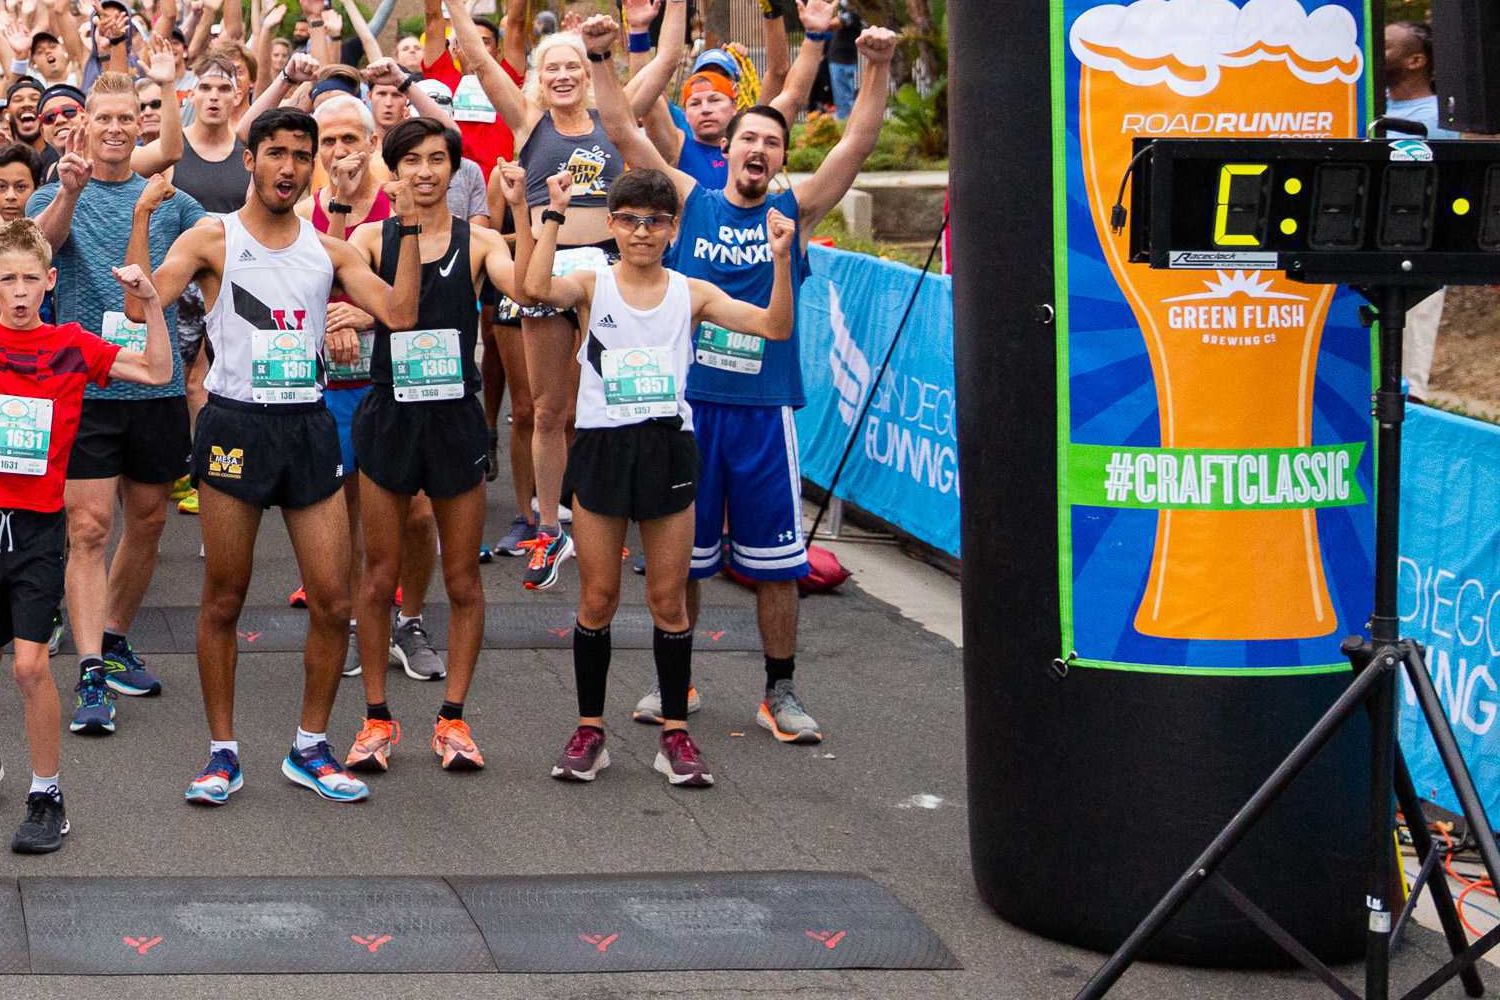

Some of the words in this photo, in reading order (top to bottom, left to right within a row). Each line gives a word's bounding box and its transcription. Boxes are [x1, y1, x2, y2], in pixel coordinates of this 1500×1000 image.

[719, 223, 765, 245] RVM
[1168, 305, 1237, 329] GREEN
[1243, 304, 1304, 329] FLASH
[1202, 334, 1260, 345] BREWING
[281, 360, 312, 379] 1361
[420, 358, 459, 377] 1360
[634, 376, 669, 394] 1357
[5, 428, 43, 450] 1631
[1, 460, 19, 470] 1631
[215, 455, 238, 465] MESA
[1104, 450, 1350, 505] #CRAFTCLASSIC
